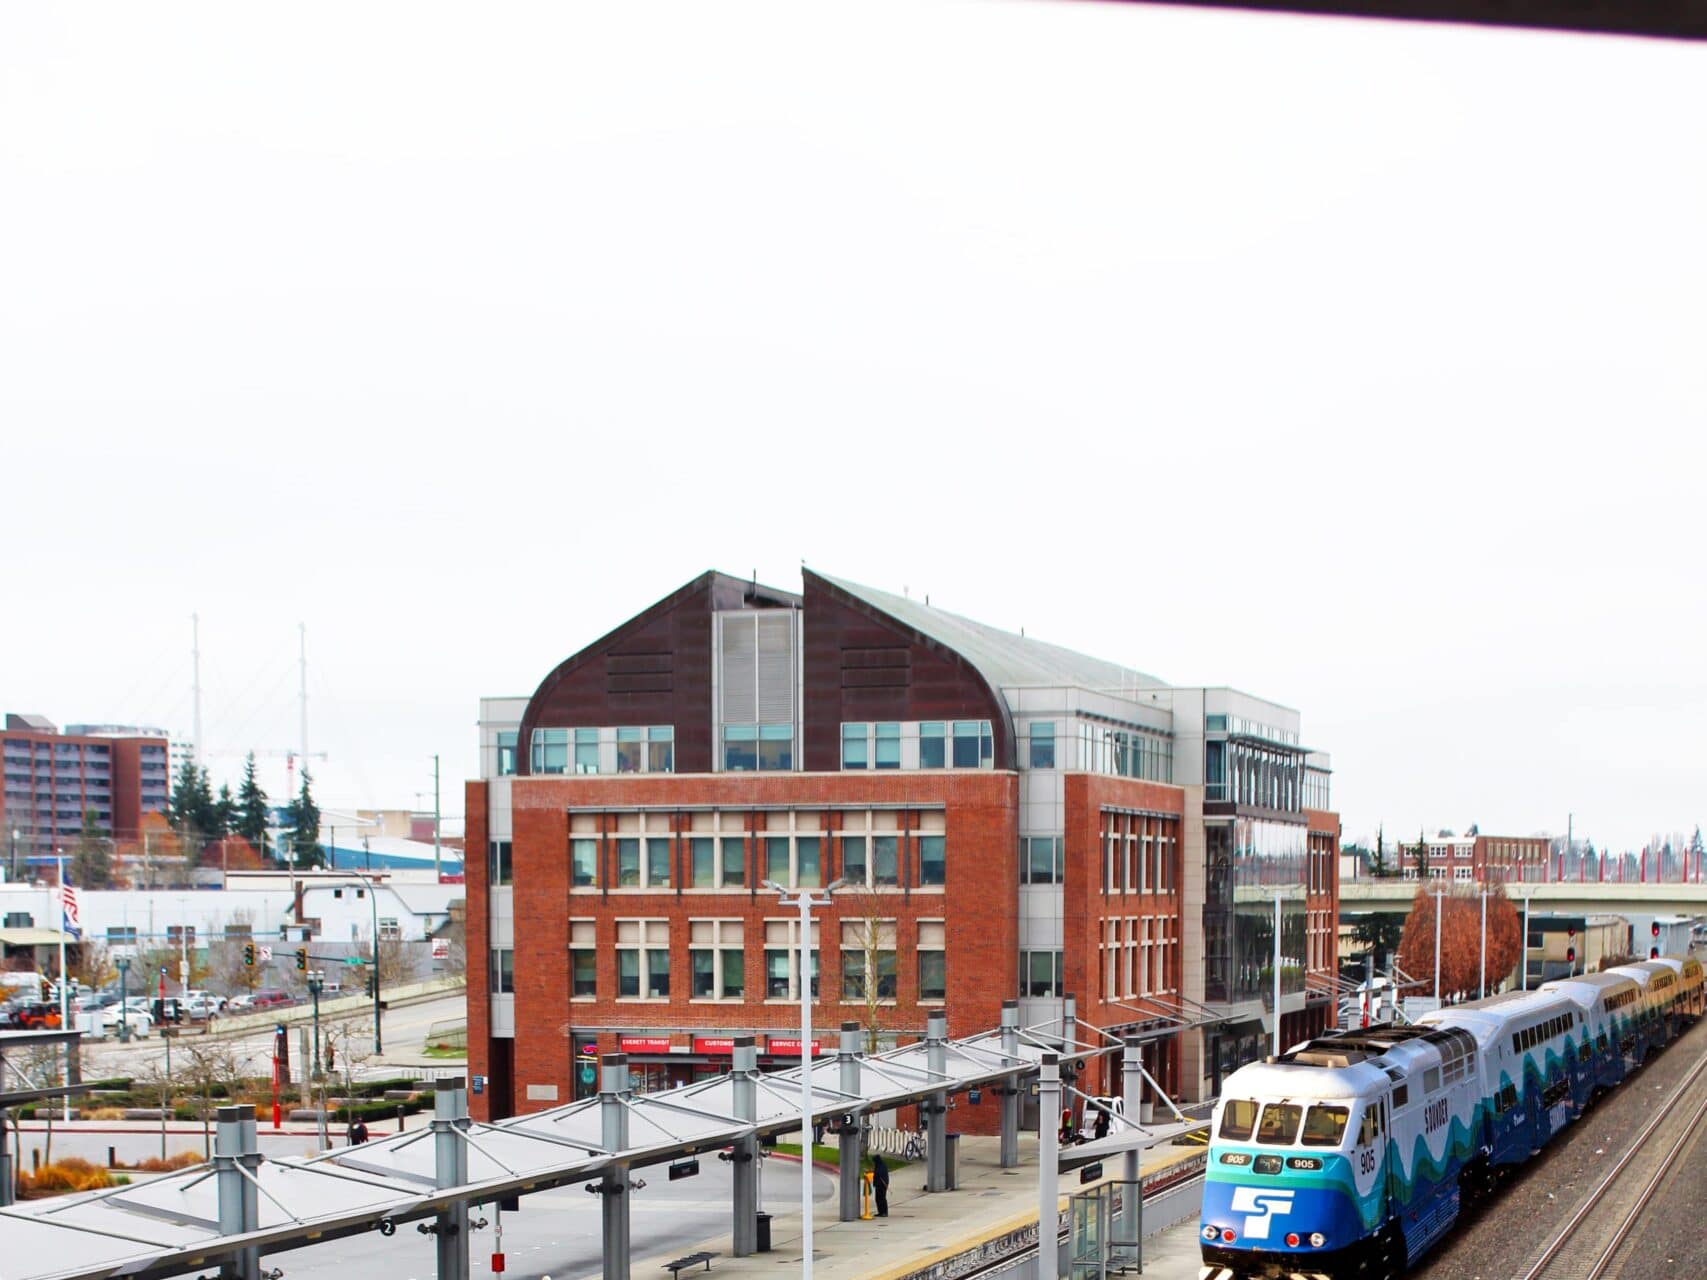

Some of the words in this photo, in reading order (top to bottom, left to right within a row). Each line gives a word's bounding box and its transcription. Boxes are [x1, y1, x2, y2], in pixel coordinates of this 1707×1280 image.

[1226, 1154, 1246, 1164] 905
[1294, 1159, 1314, 1169] 905
[1361, 1149, 1375, 1175] 905
[384, 1222, 392, 1234] 2
